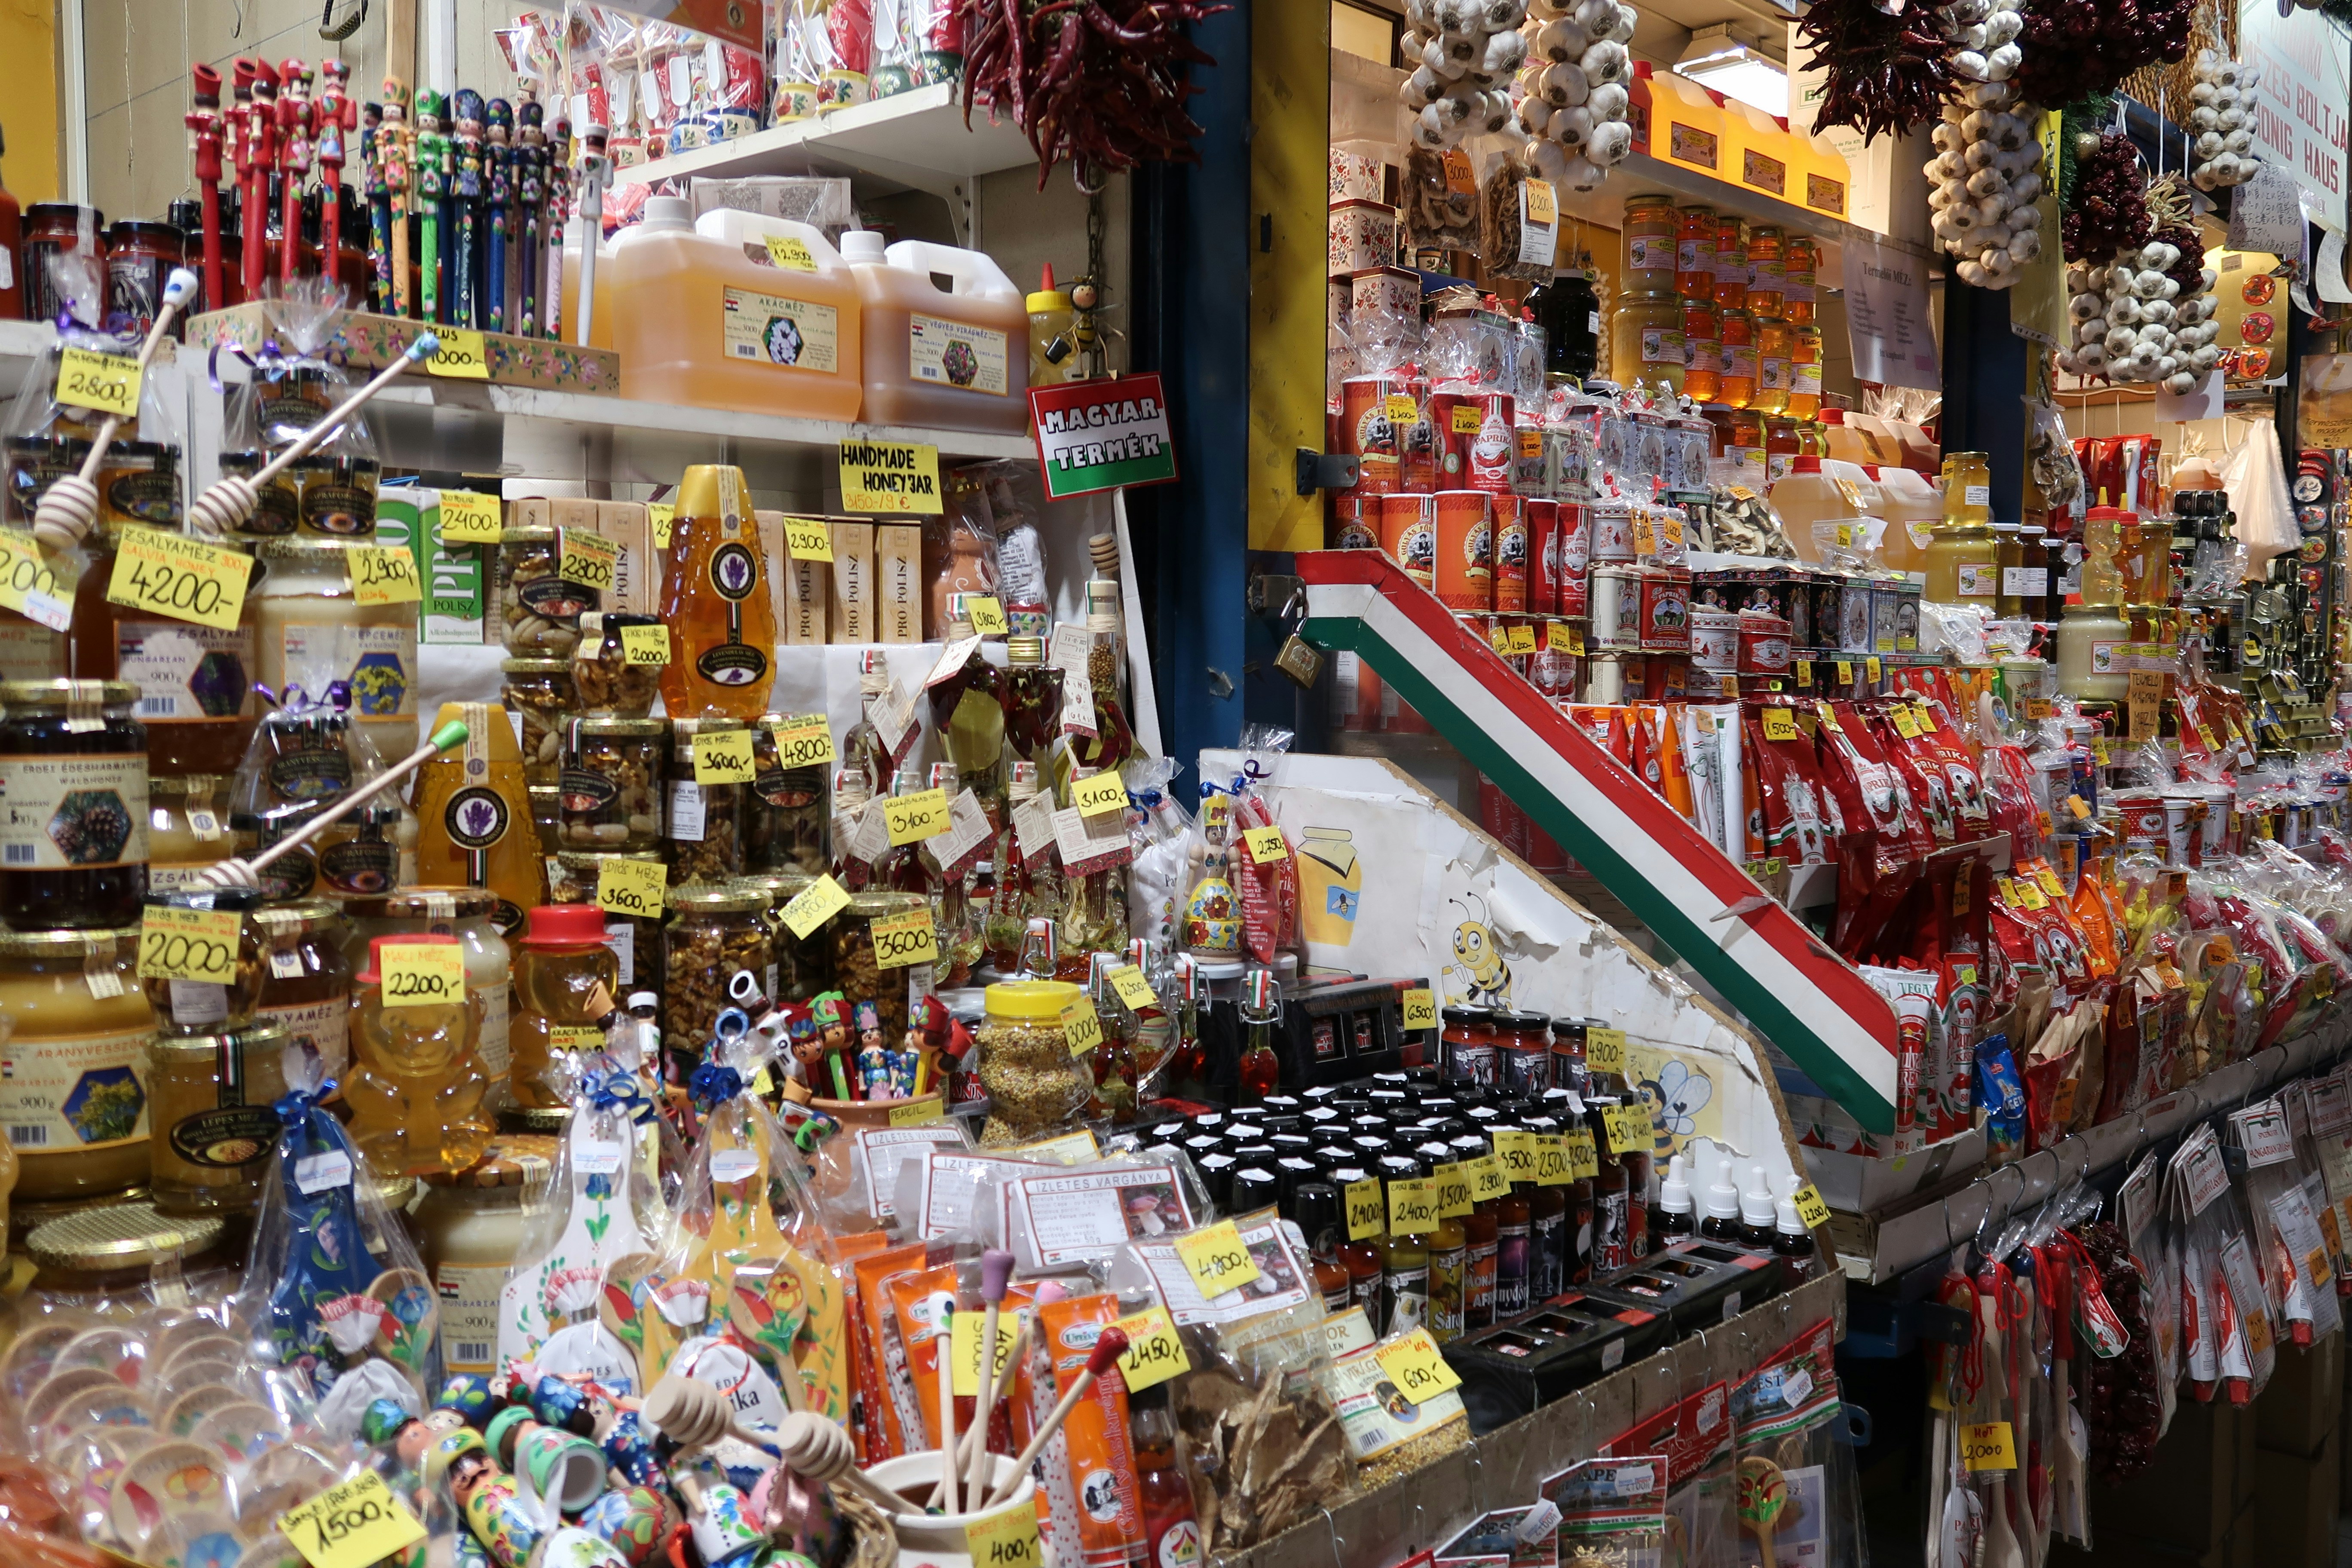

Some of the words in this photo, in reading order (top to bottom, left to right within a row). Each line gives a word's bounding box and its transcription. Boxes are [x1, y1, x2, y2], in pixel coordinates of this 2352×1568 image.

[2304, 138, 2339, 194] HAUS
[1045, 398, 1161, 434] MAGYAR
[1475, 433, 1512, 445] PAPRIKA
[841, 444, 916, 470] HANDMADE
[1054, 432, 1162, 472] TERMÉK
[433, 600, 474, 612] POLISZ
[150, 671, 175, 683] 900
[20, 1095, 46, 1110] 900
[890, 1106, 927, 1121] PENCIL
[874, 1132, 915, 1145] ÍZLETES
[1035, 1178, 1091, 1193] ÍZLETES
[1094, 1172, 1164, 1188] VARGÁNYA
[465, 1317, 488, 1329] 900
[1974, 1427, 1997, 1439] HOT
[1964, 1444, 2002, 1460] 2000
